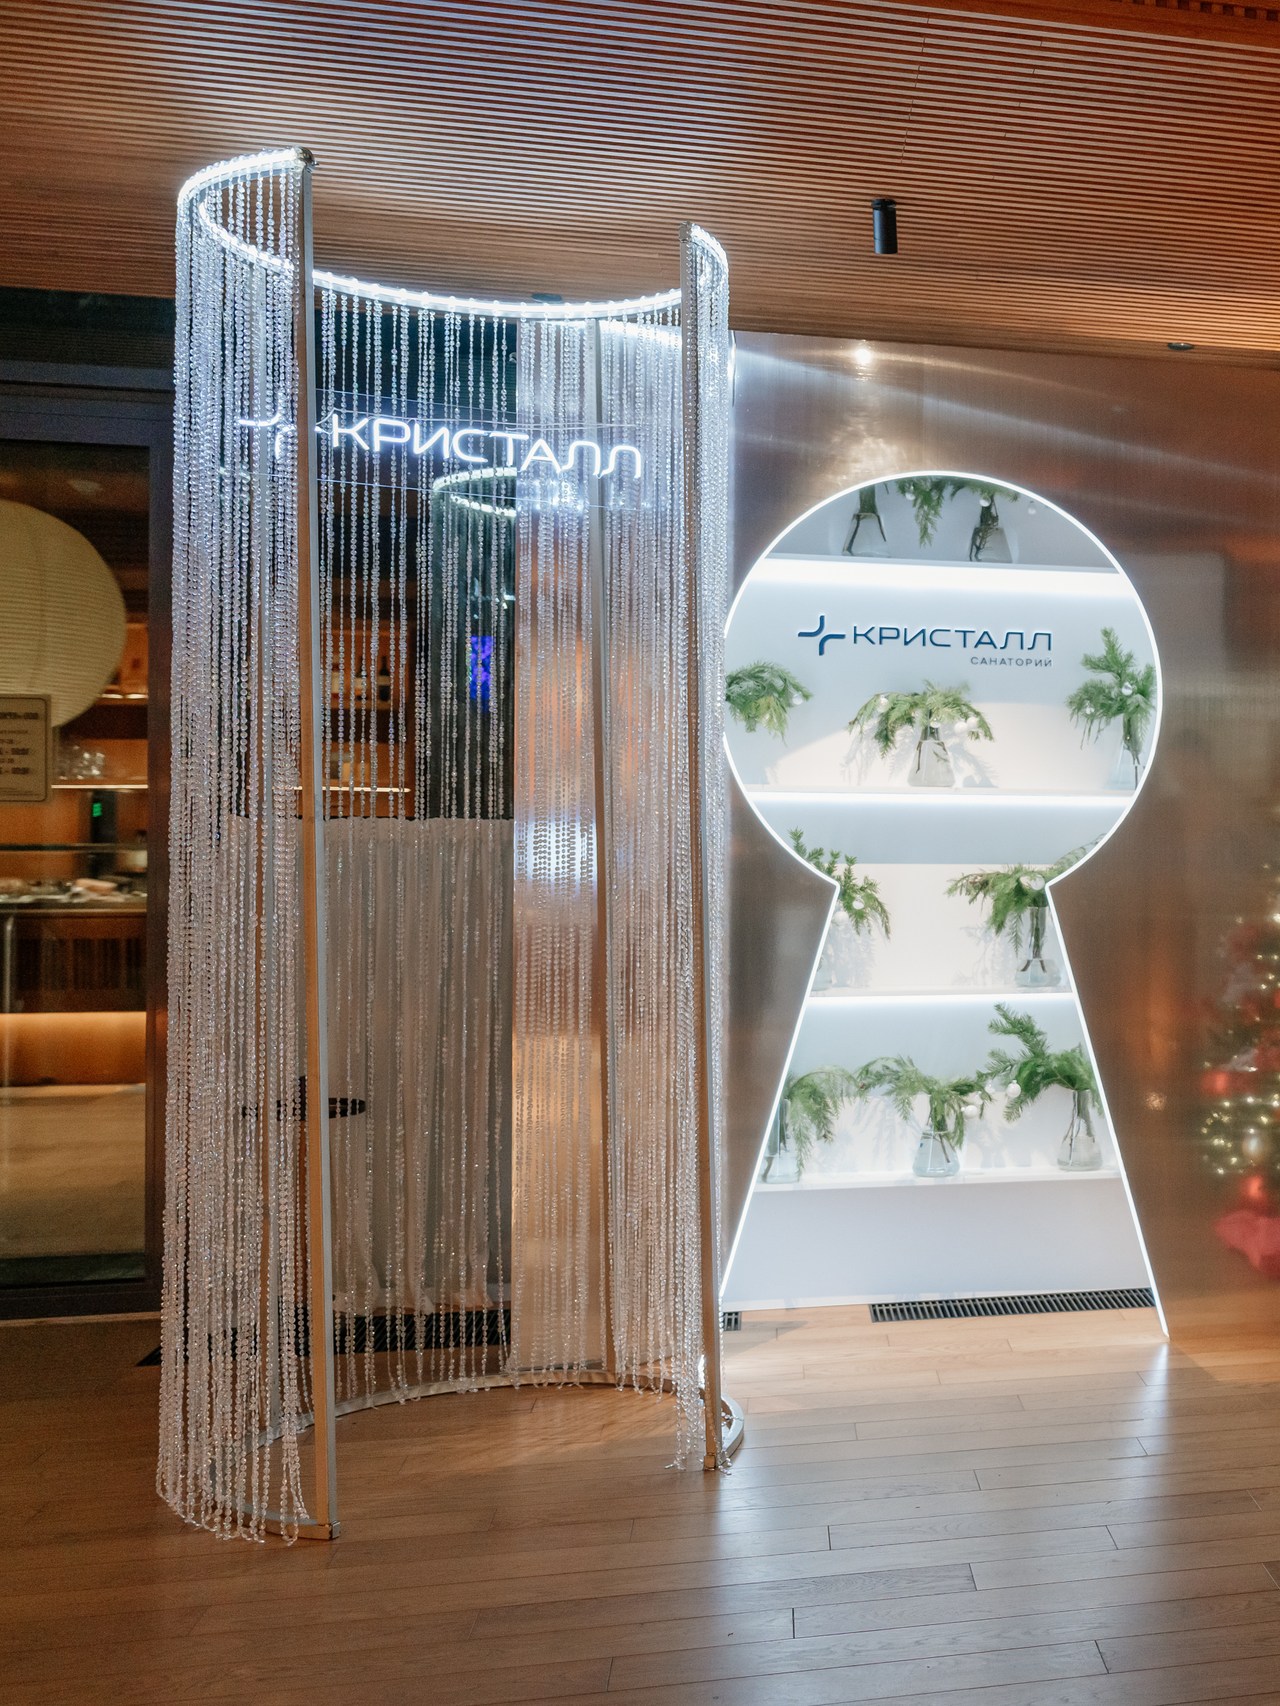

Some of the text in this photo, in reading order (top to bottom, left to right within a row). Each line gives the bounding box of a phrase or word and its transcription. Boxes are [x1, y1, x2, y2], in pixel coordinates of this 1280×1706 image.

[331, 412, 642, 479] КРИСТАЛЛ
[852, 625, 1053, 651] КРИСТАЛЛ
[970, 655, 1053, 668] САНАТОРИЙ
